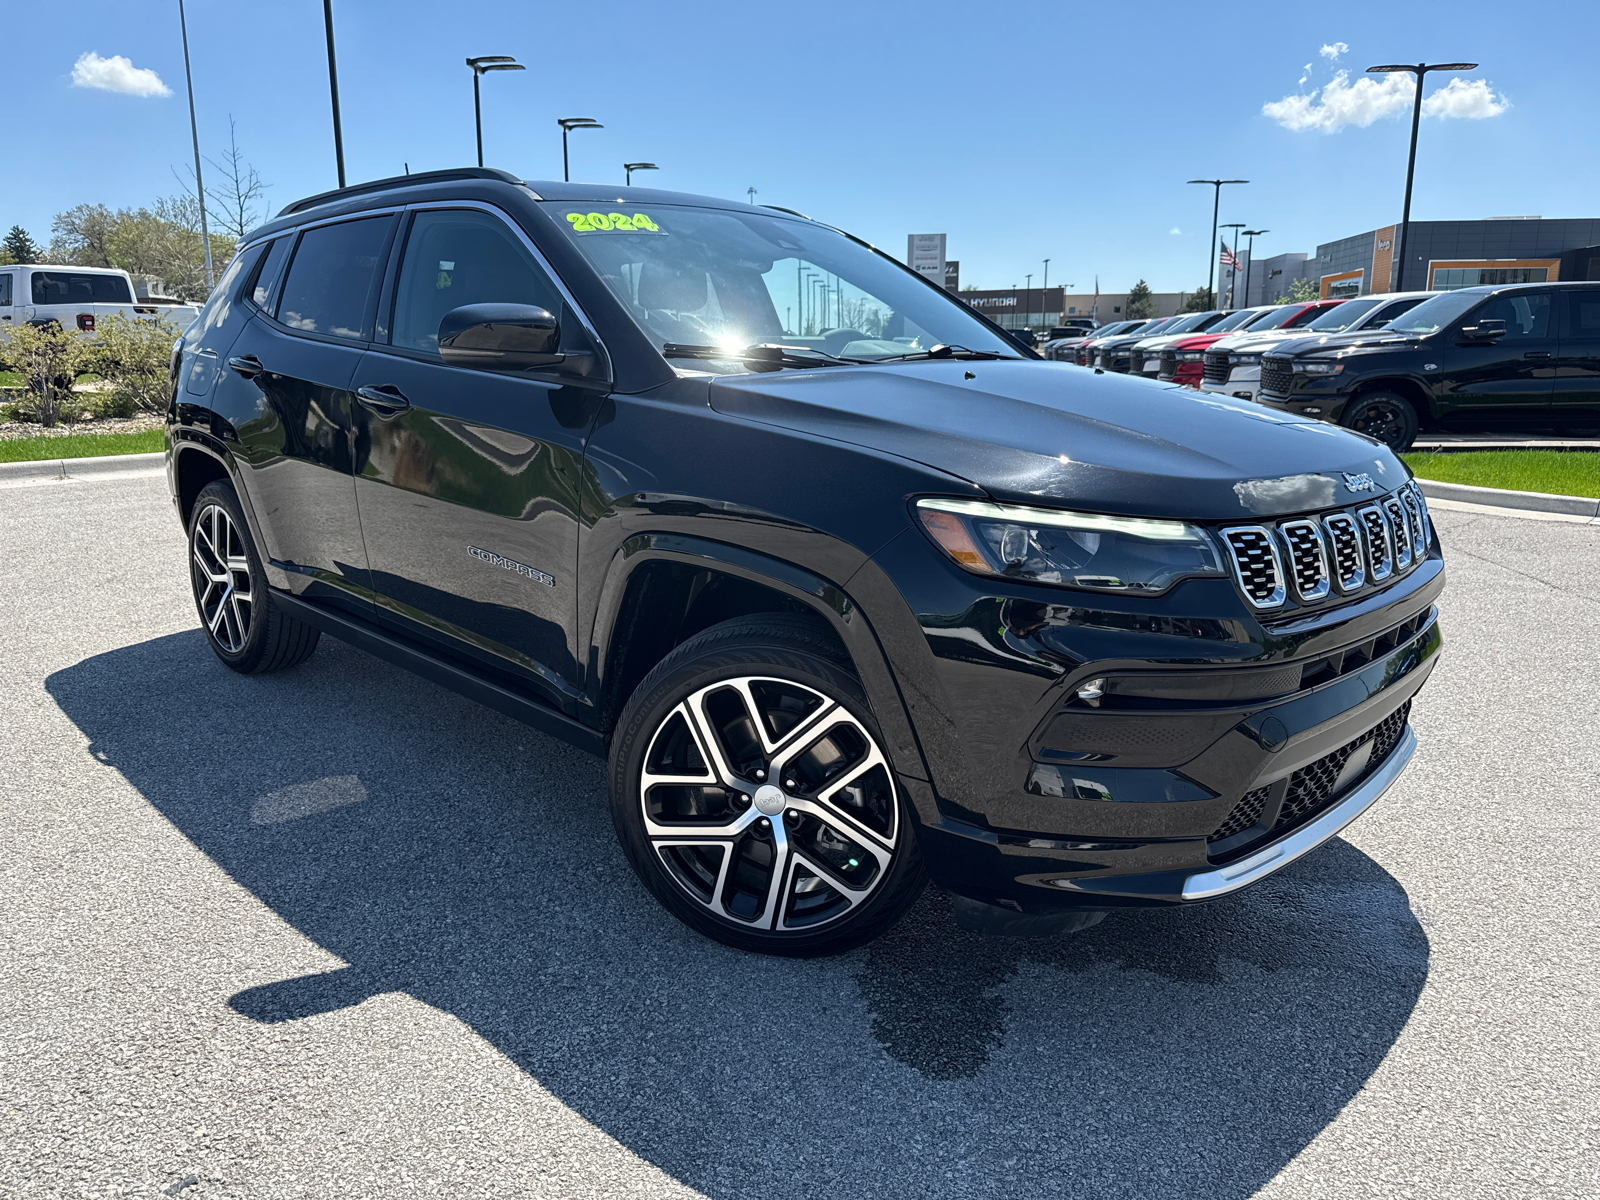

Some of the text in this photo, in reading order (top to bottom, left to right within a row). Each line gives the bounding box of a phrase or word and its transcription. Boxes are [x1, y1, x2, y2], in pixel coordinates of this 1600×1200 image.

[566, 212, 660, 232] 2024
[1377, 239, 1391, 252] Jeep
[970, 297, 1017, 308] HYUNDAI
[1342, 471, 1375, 493] Jeep
[467, 545, 556, 588] COMPASS
[616, 682, 672, 805] ContiProContact
[758, 793, 782, 808] Jeep
